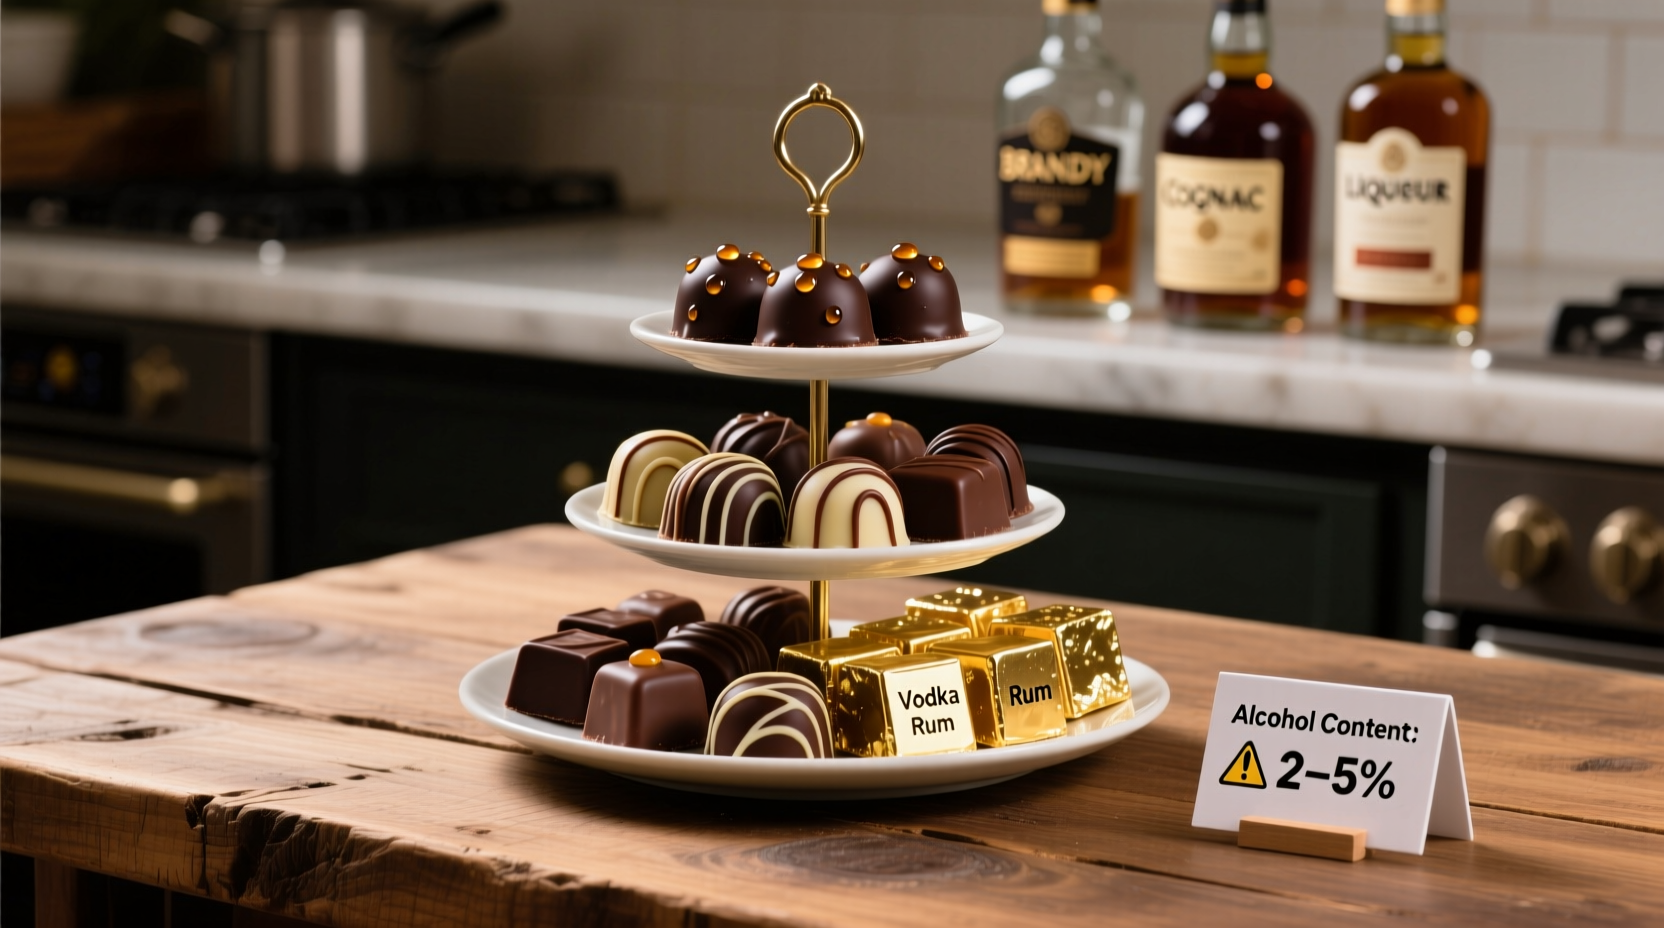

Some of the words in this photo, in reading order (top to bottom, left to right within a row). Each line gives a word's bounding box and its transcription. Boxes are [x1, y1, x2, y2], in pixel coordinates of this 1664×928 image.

[999, 145, 1112, 185] BRANDY
[1162, 178, 1265, 214] COGNAC
[898, 686, 960, 710] Vodka
[1009, 684, 1053, 706] Rum
[911, 716, 955, 735] Rum
[1231, 704, 1316, 731] Alcohol
[1320, 713, 1419, 743] Content:
[1276, 750, 1396, 799] 2–5%
